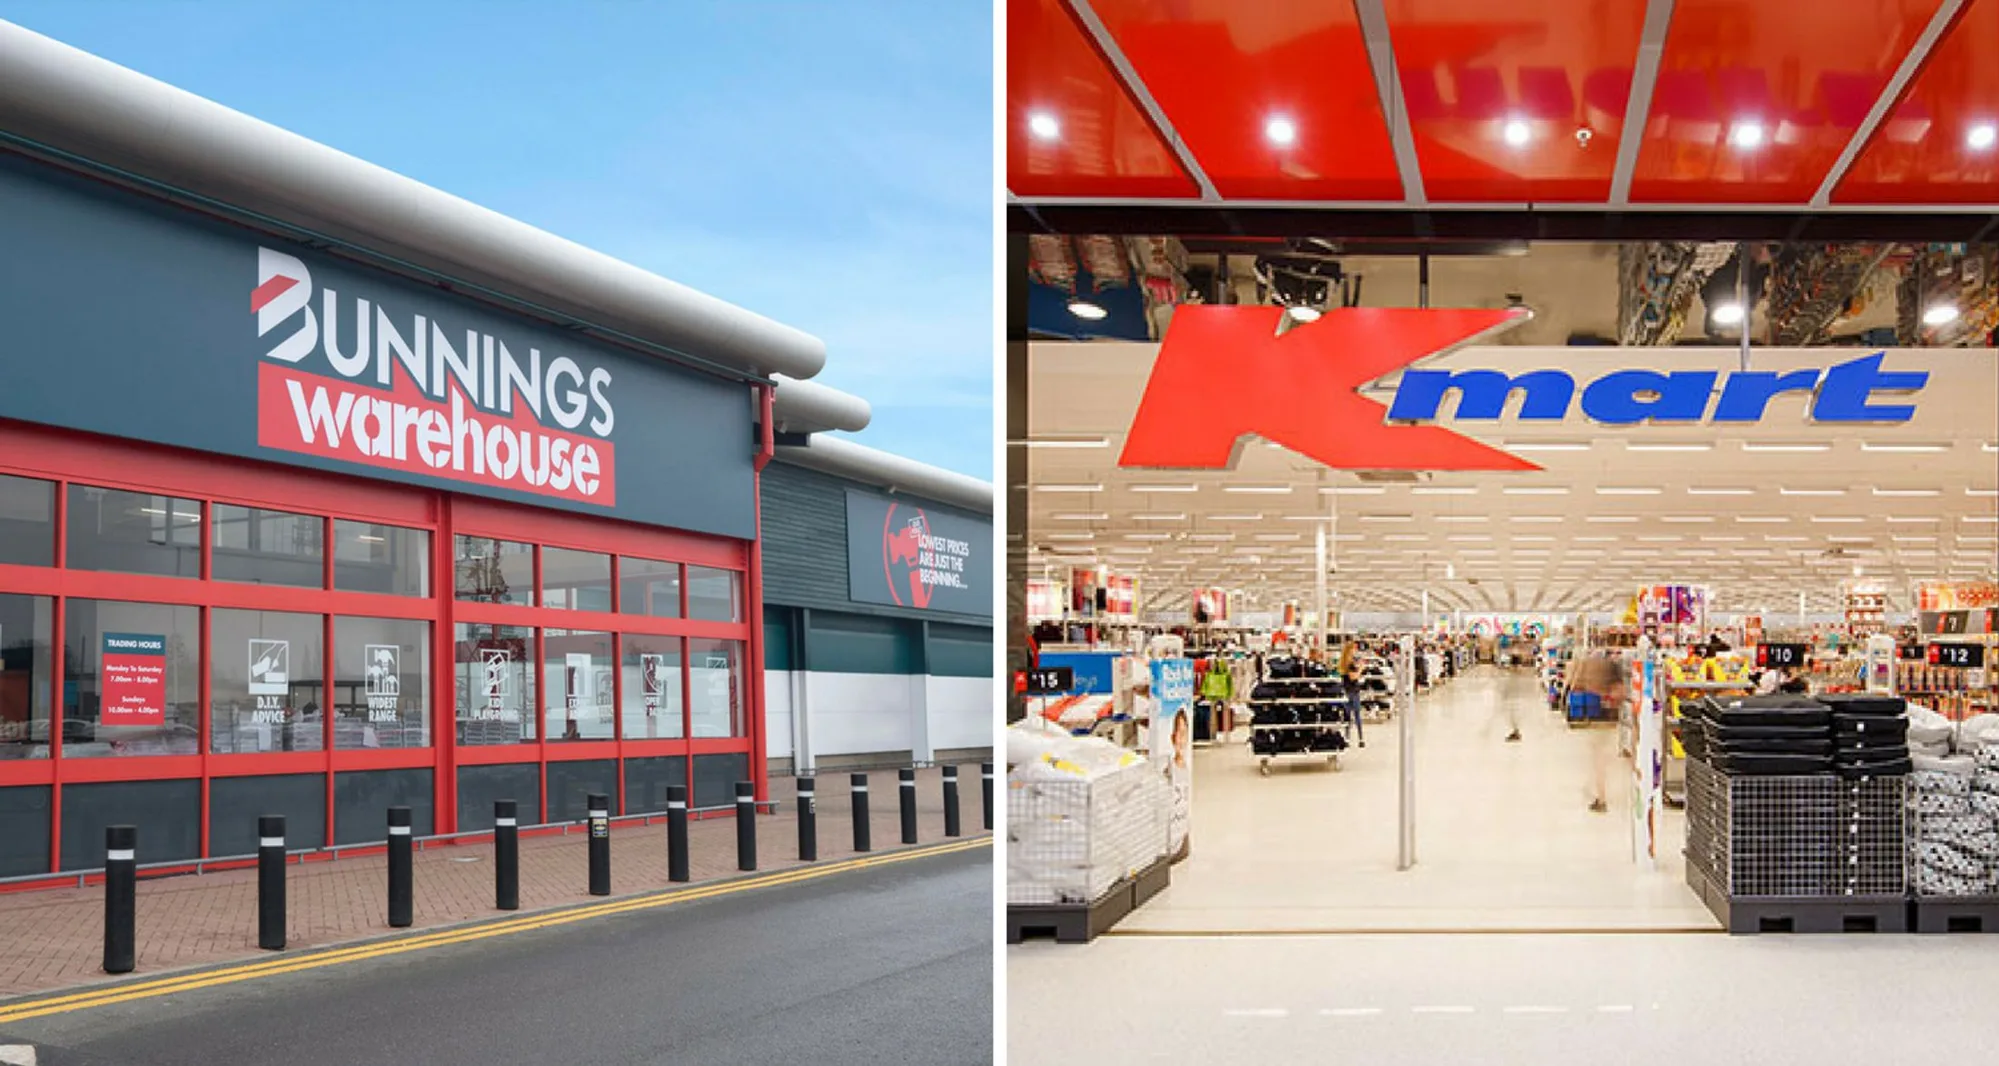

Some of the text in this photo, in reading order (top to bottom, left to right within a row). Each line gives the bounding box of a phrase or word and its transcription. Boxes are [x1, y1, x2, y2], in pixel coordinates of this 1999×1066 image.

[251, 246, 615, 438] BUNNINGS
[1117, 304, 1932, 473] Kmart
[285, 379, 601, 496] warehouse
[918, 534, 969, 557] LOWEST PRICES
[919, 551, 964, 572] ARE JUST THE
[108, 640, 161, 649] TRADING HOURS
[106, 665, 129, 673] Monday
[257, 696, 281, 709] D.I.Y.
[367, 697, 398, 709] WIDEST
[251, 710, 286, 723] ADVICE
[368, 710, 397, 722] RANGE
